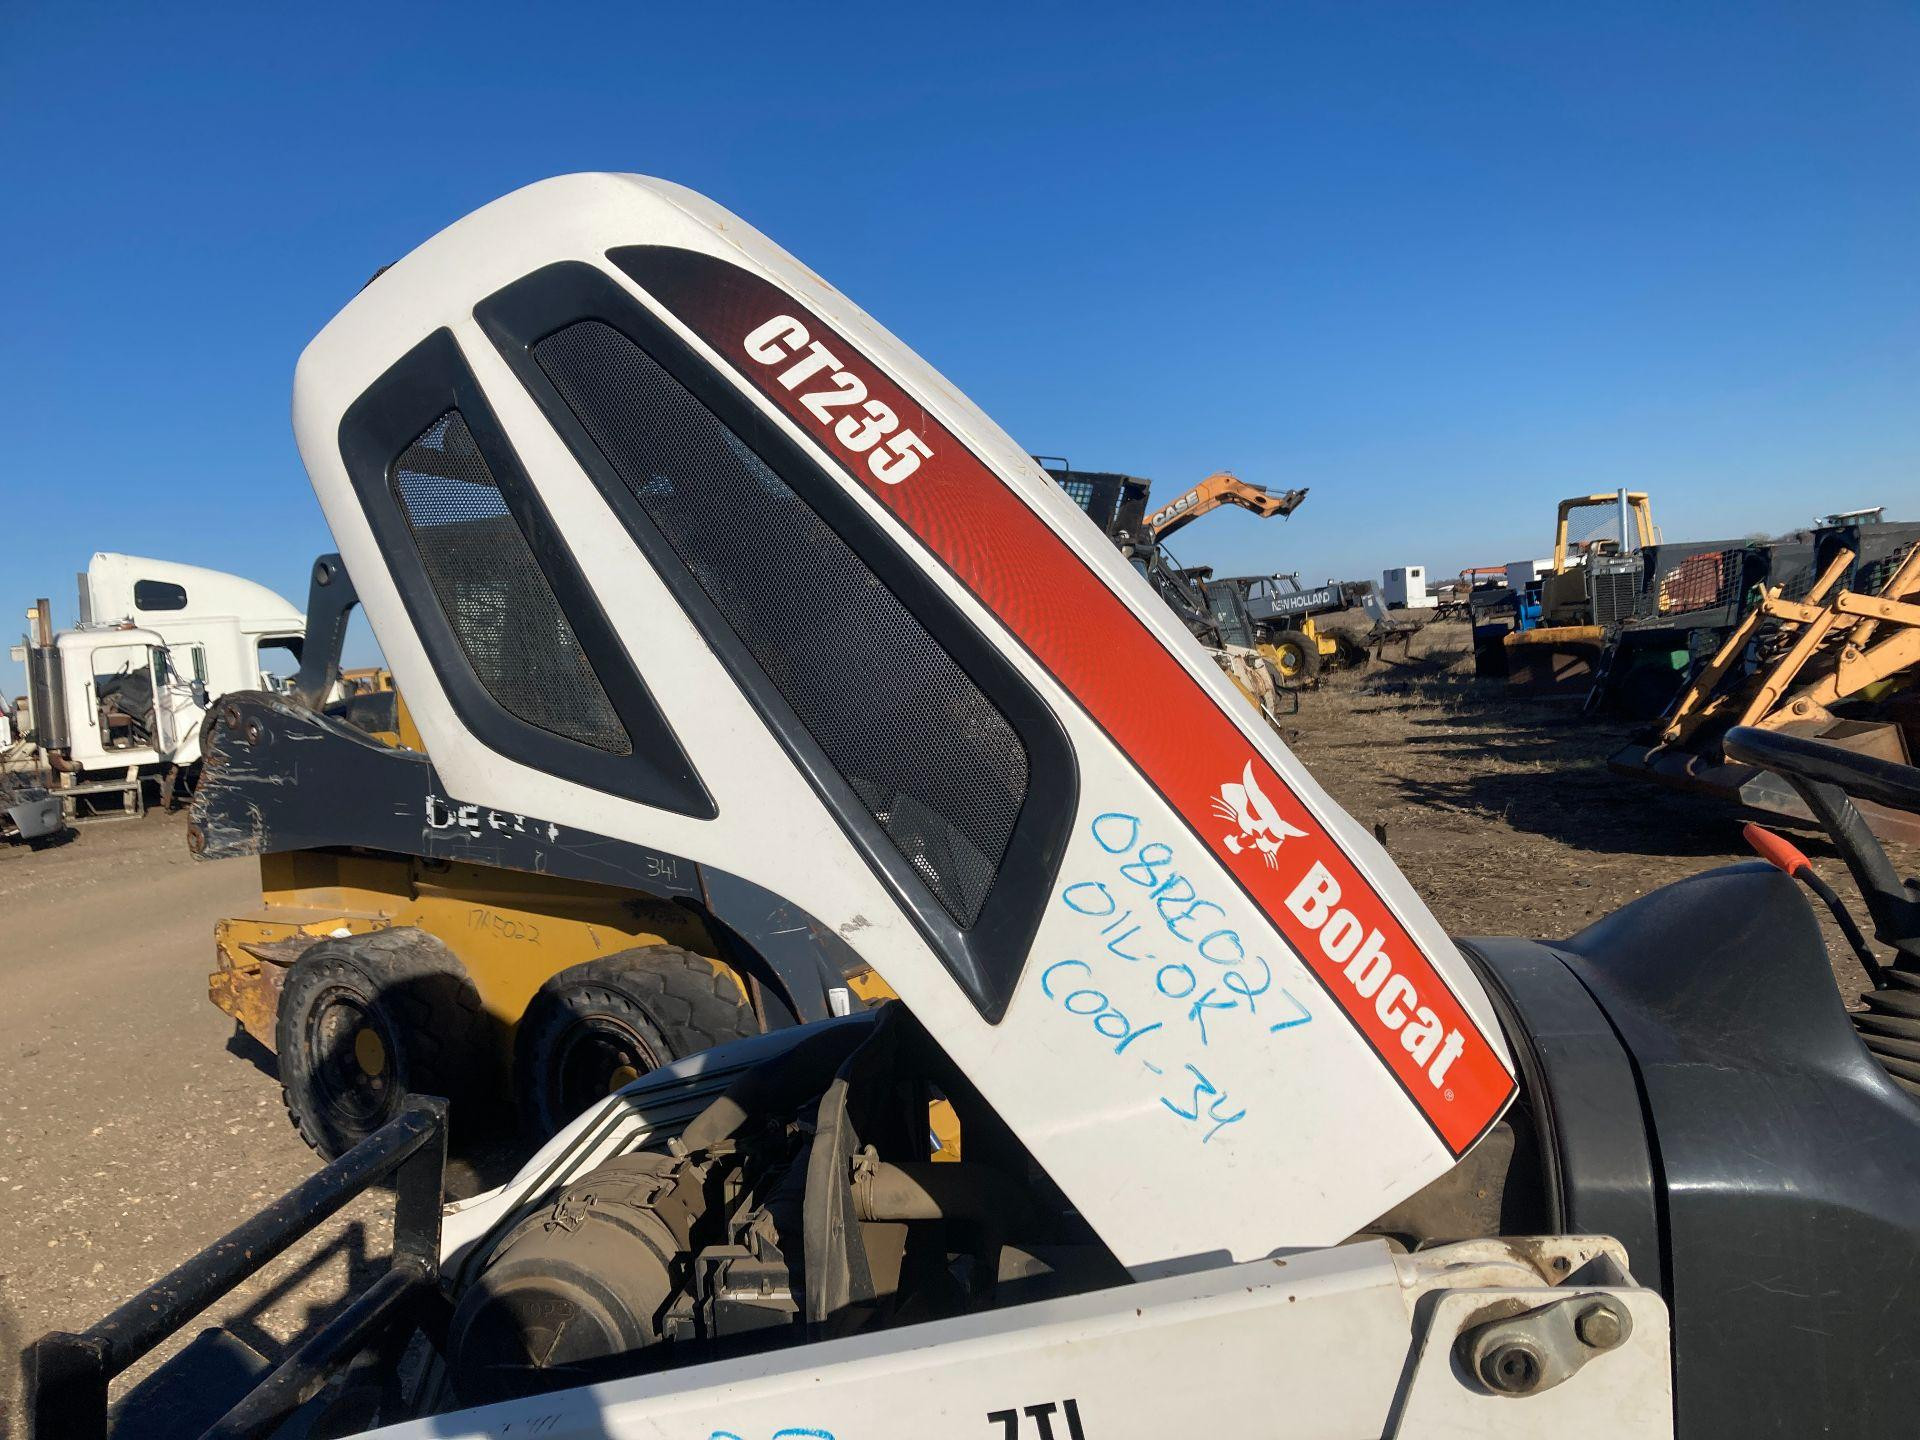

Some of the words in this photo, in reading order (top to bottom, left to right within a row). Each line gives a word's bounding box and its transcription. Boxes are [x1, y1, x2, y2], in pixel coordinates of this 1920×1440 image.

[744, 315, 935, 485] CT235
[1153, 490, 1199, 527] CASE
[1271, 600, 1290, 612] NEW
[1290, 592, 1330, 609] HOLLAND
[1284, 860, 1466, 1089] Bobcat
